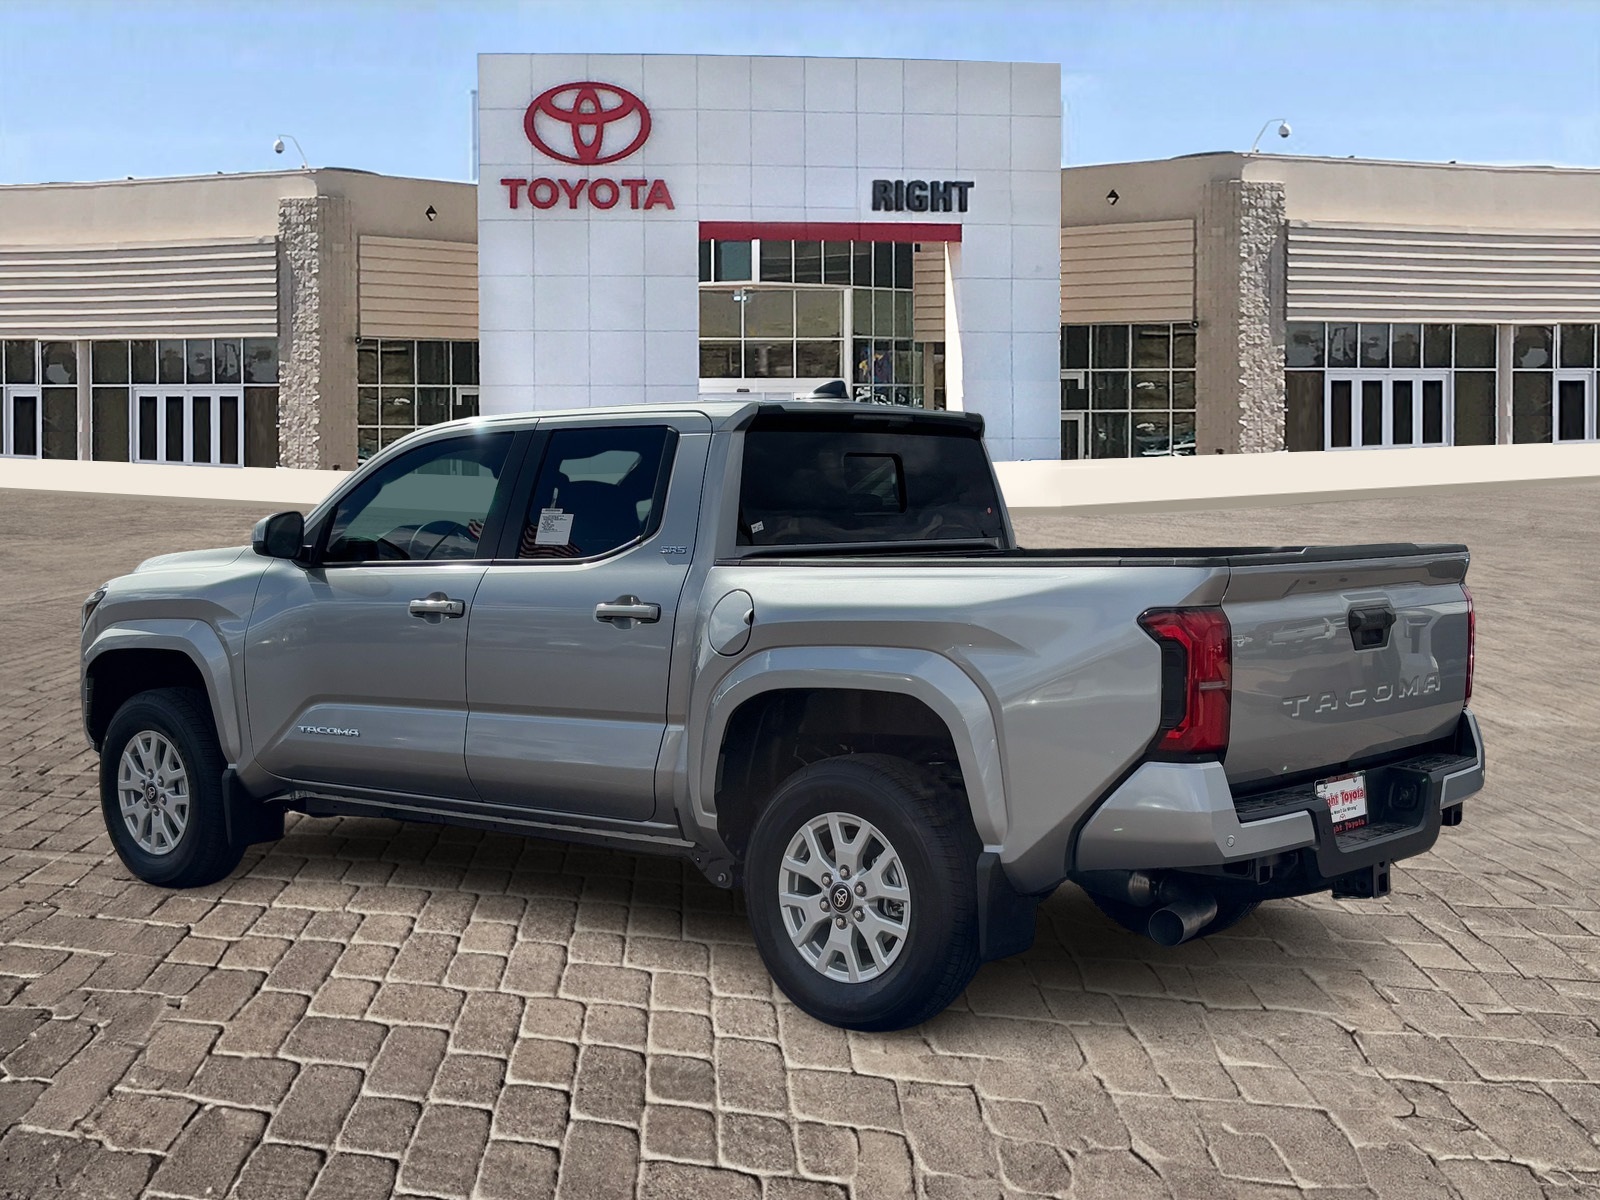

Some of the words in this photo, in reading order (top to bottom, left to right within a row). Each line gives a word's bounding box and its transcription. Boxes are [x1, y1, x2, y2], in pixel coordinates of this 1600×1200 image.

[500, 177, 675, 210] TOYOTA
[872, 179, 975, 212] RIGHT
[1282, 671, 1441, 717] TACOMA
[298, 725, 360, 737] TACOMA
[1340, 787, 1365, 806] Toyota
